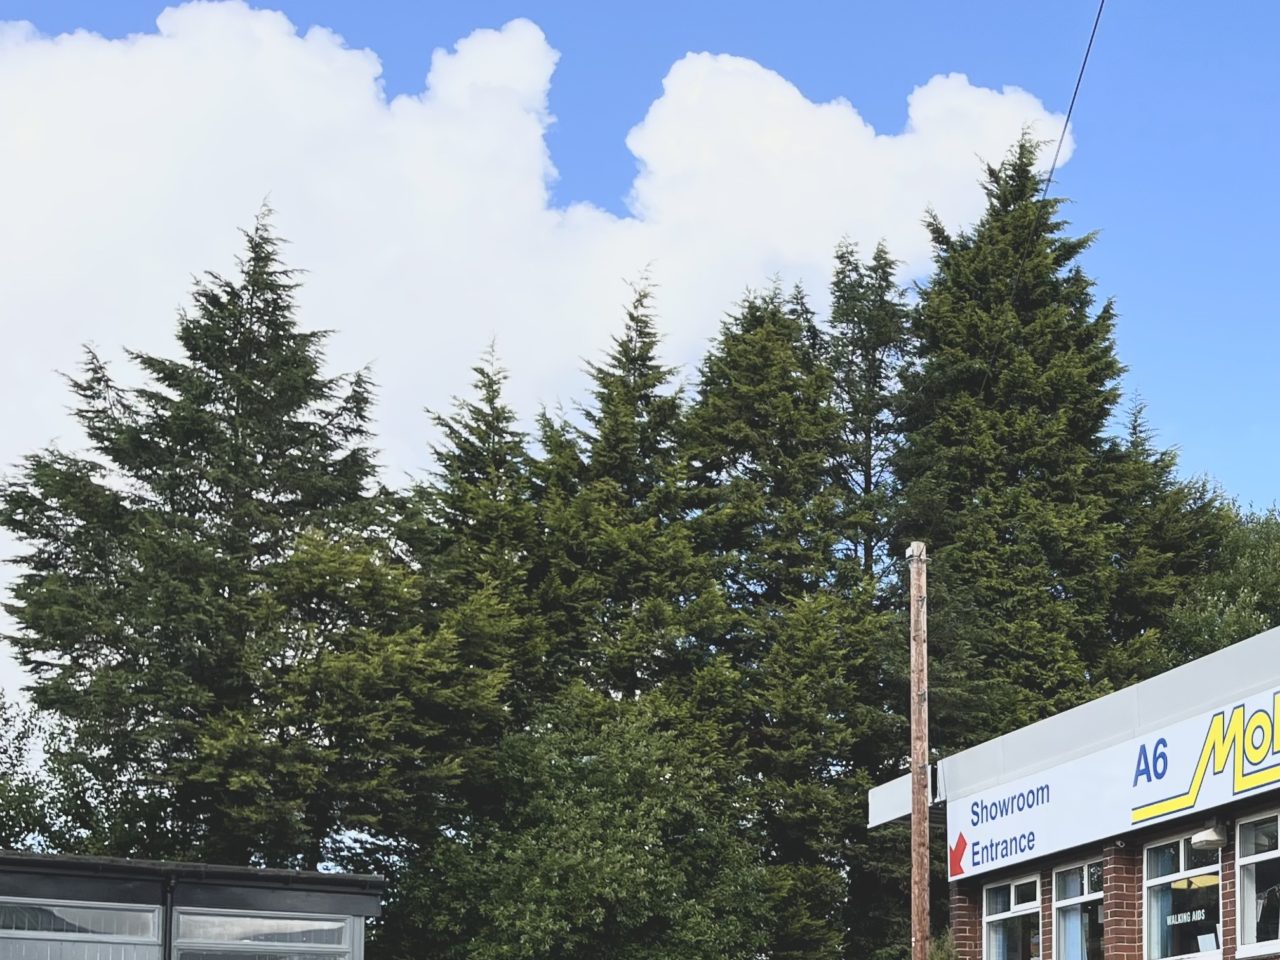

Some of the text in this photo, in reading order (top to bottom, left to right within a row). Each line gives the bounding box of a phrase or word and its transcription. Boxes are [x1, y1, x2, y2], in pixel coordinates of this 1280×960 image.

[1132, 737, 1168, 788] A6
[970, 783, 1050, 827] Showroom
[971, 831, 1036, 867] Entrance
[1166, 908, 1205, 926] WALKING AIDS
